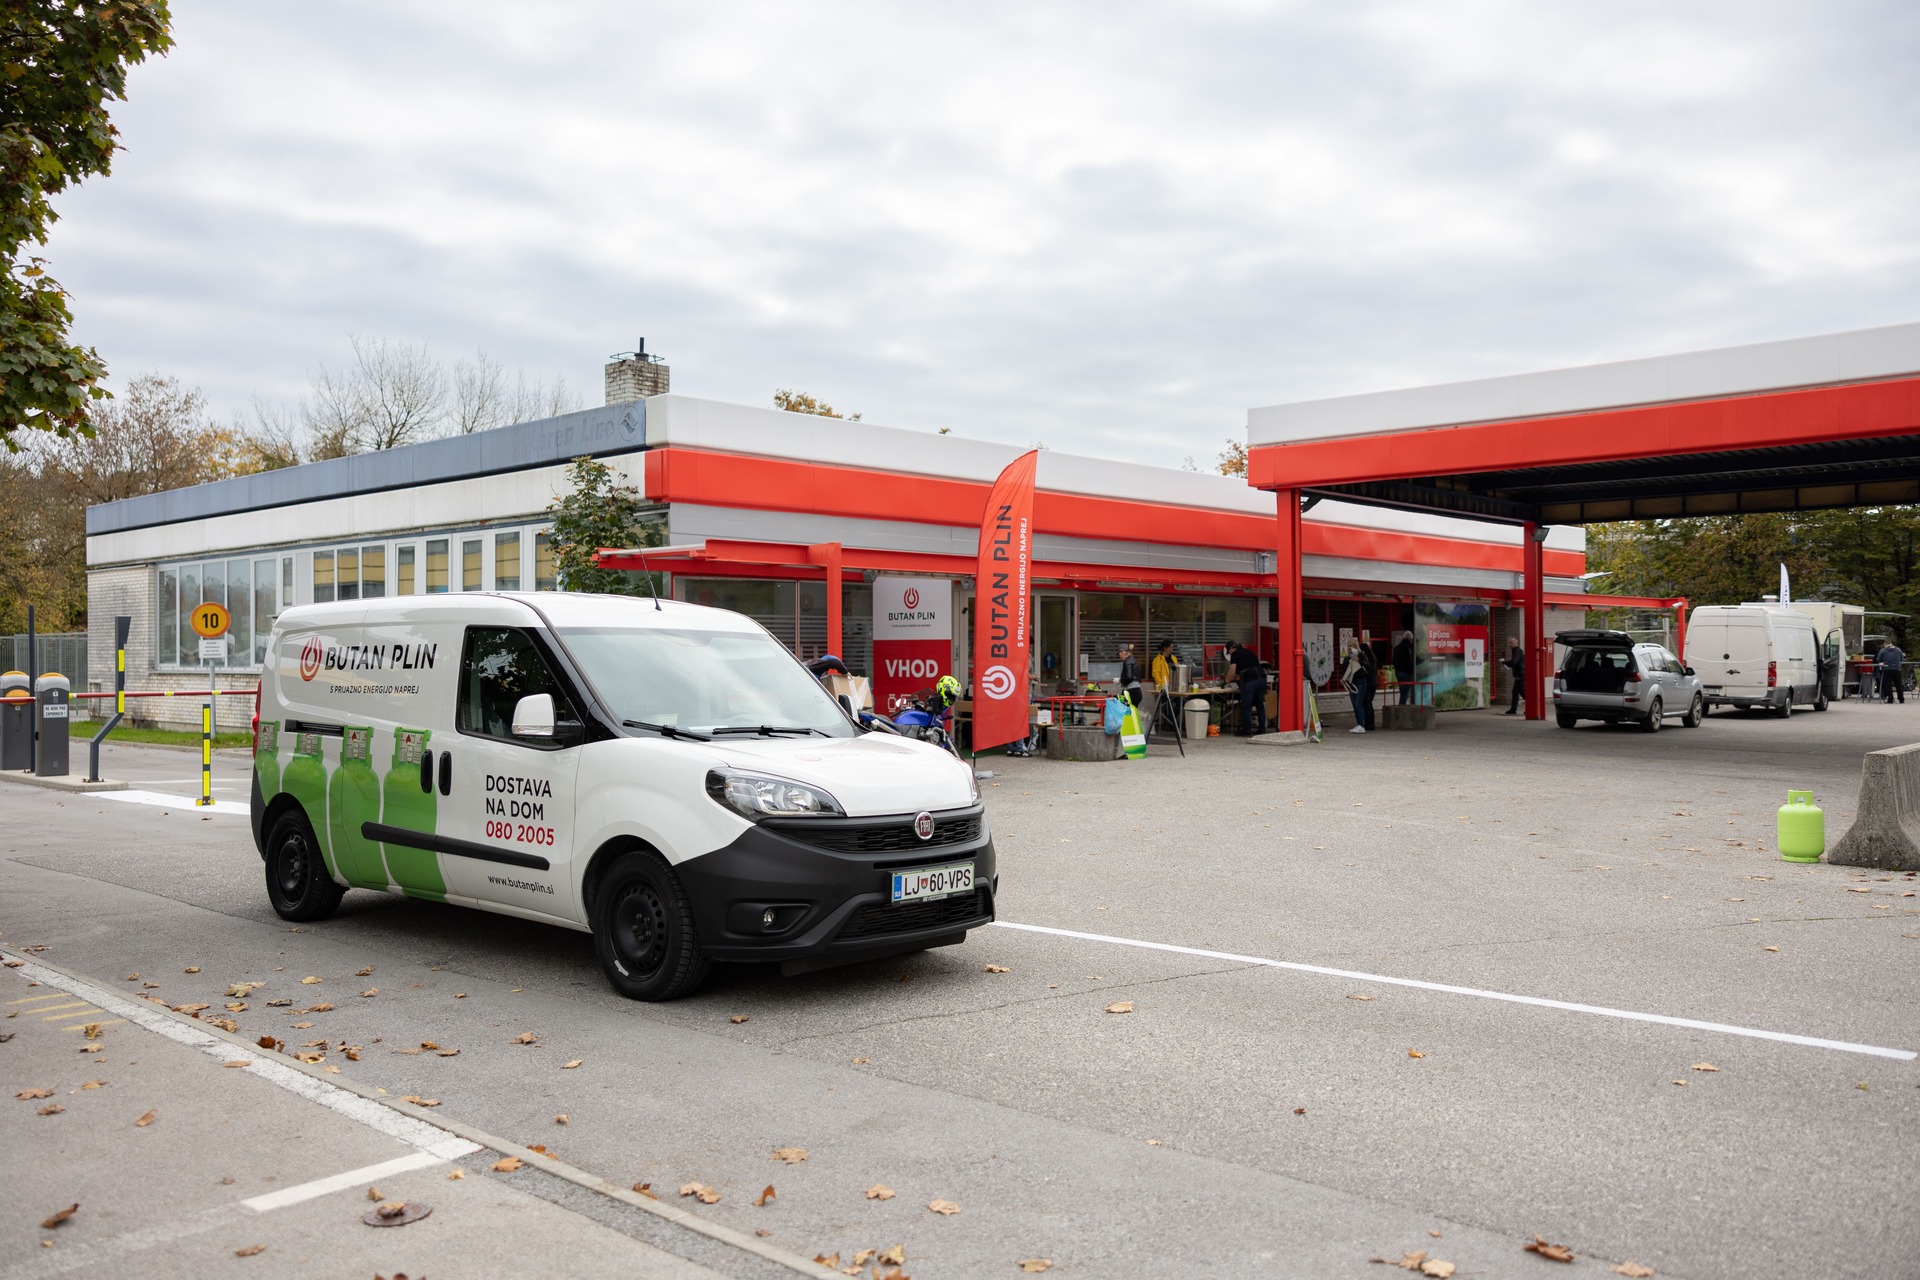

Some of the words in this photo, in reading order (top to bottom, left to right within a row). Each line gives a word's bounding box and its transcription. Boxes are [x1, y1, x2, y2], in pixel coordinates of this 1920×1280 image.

[993, 505, 1012, 561] PLIN
[1019, 517, 1028, 551] NAPREJ
[1019, 553, 1027, 596] ENERGIJO
[202, 612, 219, 629] 10
[888, 612, 915, 621] BUTAN
[918, 611, 936, 620] PLIN
[991, 573, 1009, 658] BUTAN
[1017, 597, 1026, 640] PRIJAZNO
[325, 644, 386, 671] BUTAN
[390, 643, 438, 670] PLIN
[885, 659, 939, 678] VHOD
[329, 685, 334, 694] S
[334, 685, 362, 694] PRIJAZNO
[362, 685, 393, 694] ENERGIJO
[394, 685, 420, 694] NAPREJ
[486, 774, 552, 798] DOSTAVA
[486, 797, 506, 816] NA
[511, 800, 544, 820] DOM
[486, 820, 513, 840] 080
[516, 824, 555, 846] 2005
[920, 819, 931, 833] FIAT
[487, 875, 555, 895] www.butanplin.si
[929, 868, 971, 892] 60-VPS
